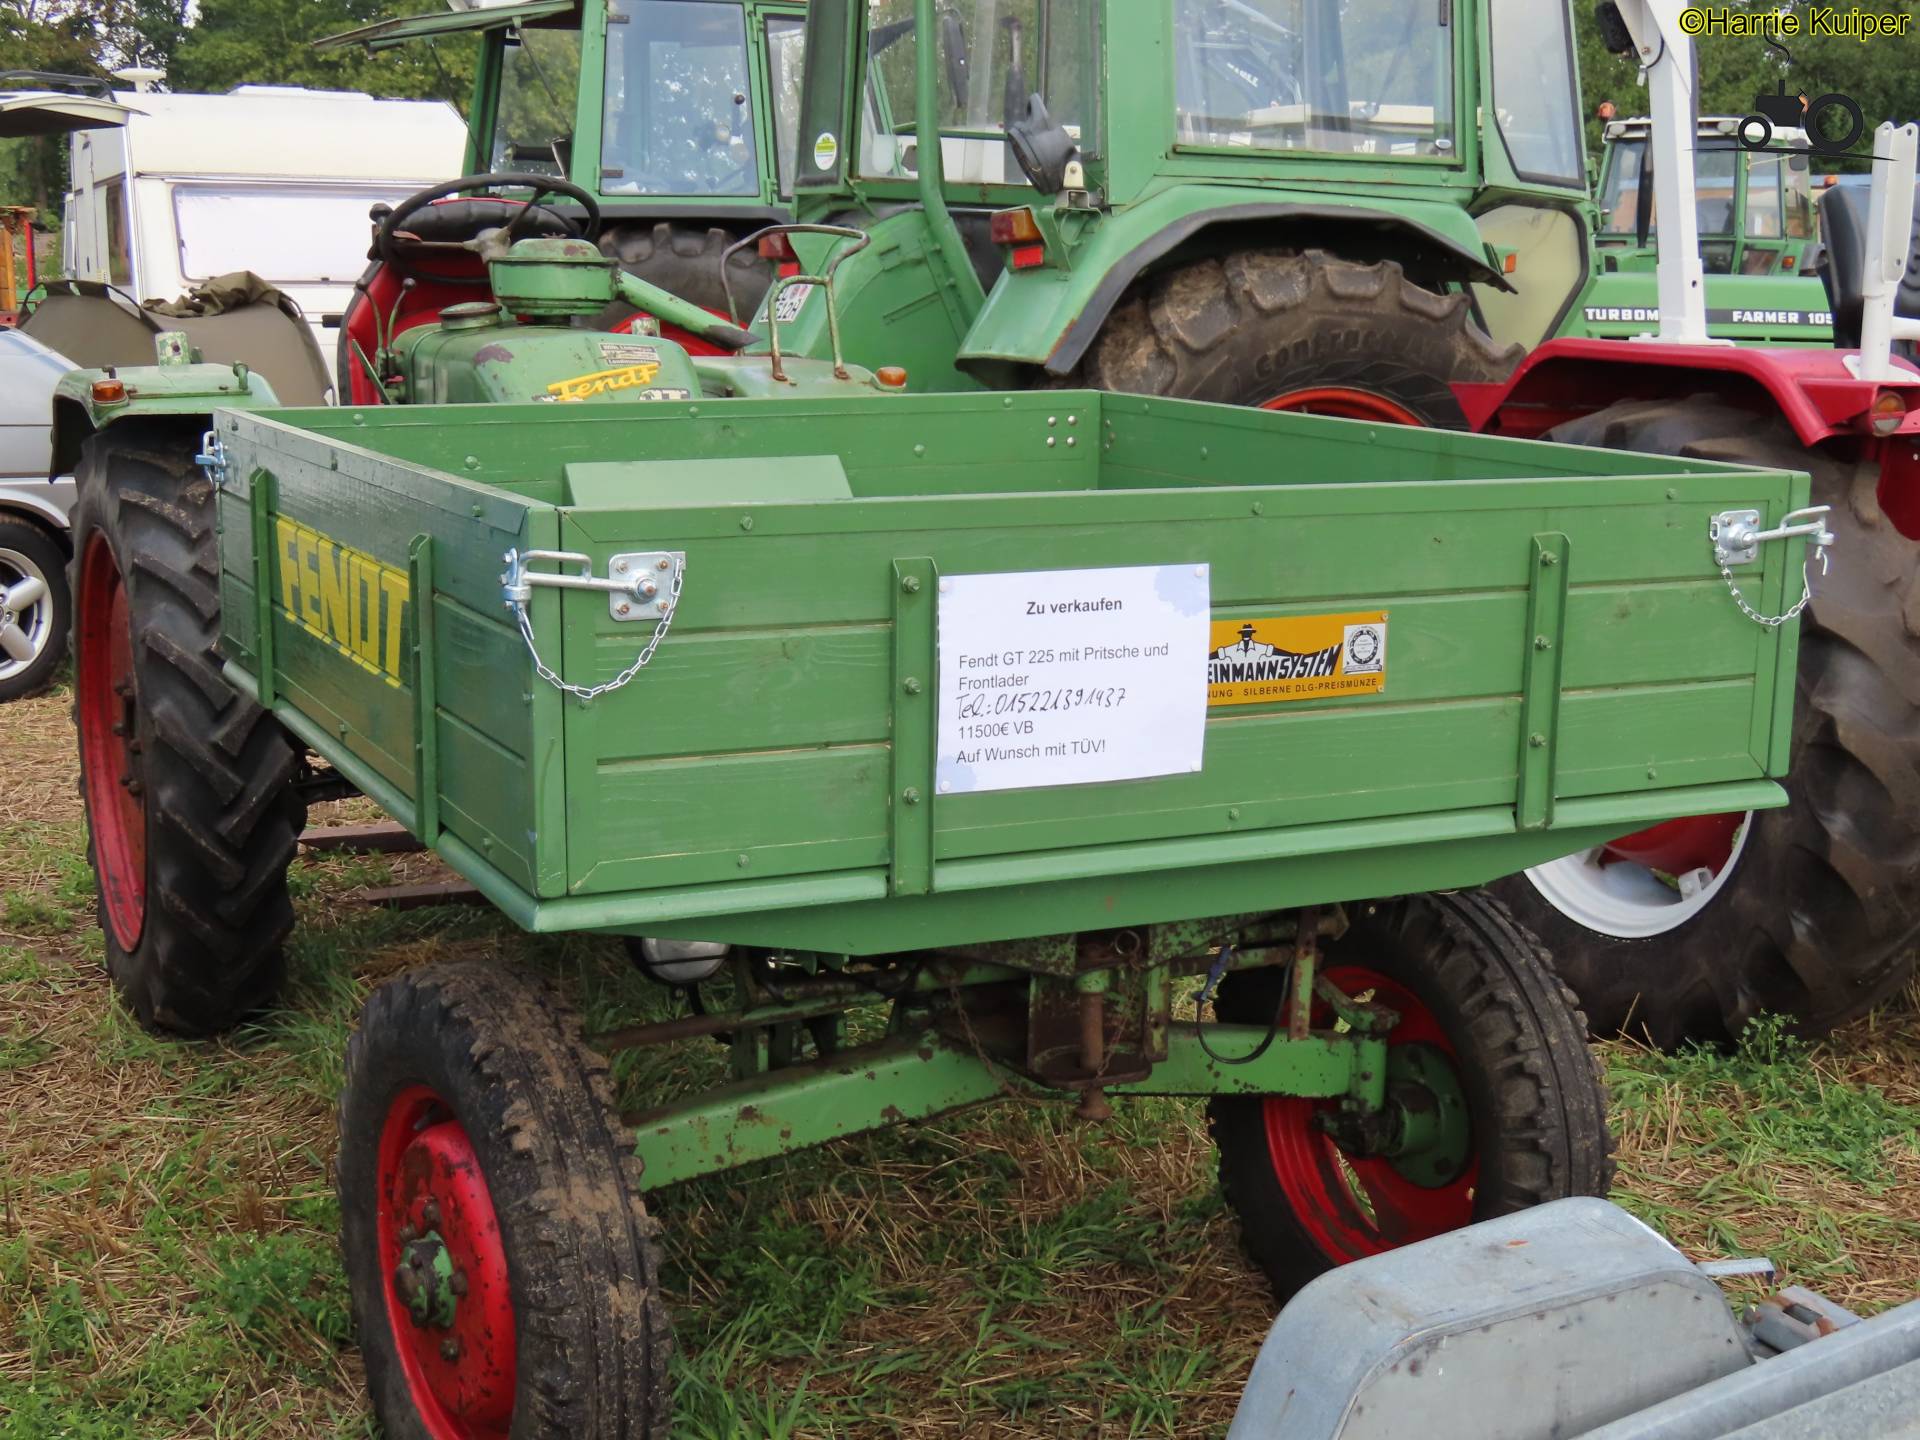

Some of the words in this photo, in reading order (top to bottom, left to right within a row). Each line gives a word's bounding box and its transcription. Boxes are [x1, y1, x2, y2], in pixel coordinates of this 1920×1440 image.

[1732, 311, 1799, 324] FARMER
[547, 363, 658, 402] Fendt
[275, 512, 410, 689] FENDT
[1026, 601, 1046, 615] Zu
[1050, 597, 1123, 614] verkaufen
[959, 653, 999, 669] Fendt
[1003, 651, 1024, 666] GT
[1028, 649, 1055, 665] 225
[1059, 648, 1080, 662] mit
[1084, 644, 1140, 661] Pritsche
[1144, 642, 1169, 657] und
[1208, 643, 1342, 684] EINMANNSYSTEM
[959, 674, 1030, 691] Frontlader
[1243, 685, 1291, 696] SILBERNE
[958, 722, 1010, 740] 11500€
[1013, 720, 1034, 735] VB
[956, 748, 982, 765] Auf
[985, 744, 1040, 761] Wunsch
[1045, 742, 1067, 757] mit
[1071, 738, 1106, 755] TÜV!
